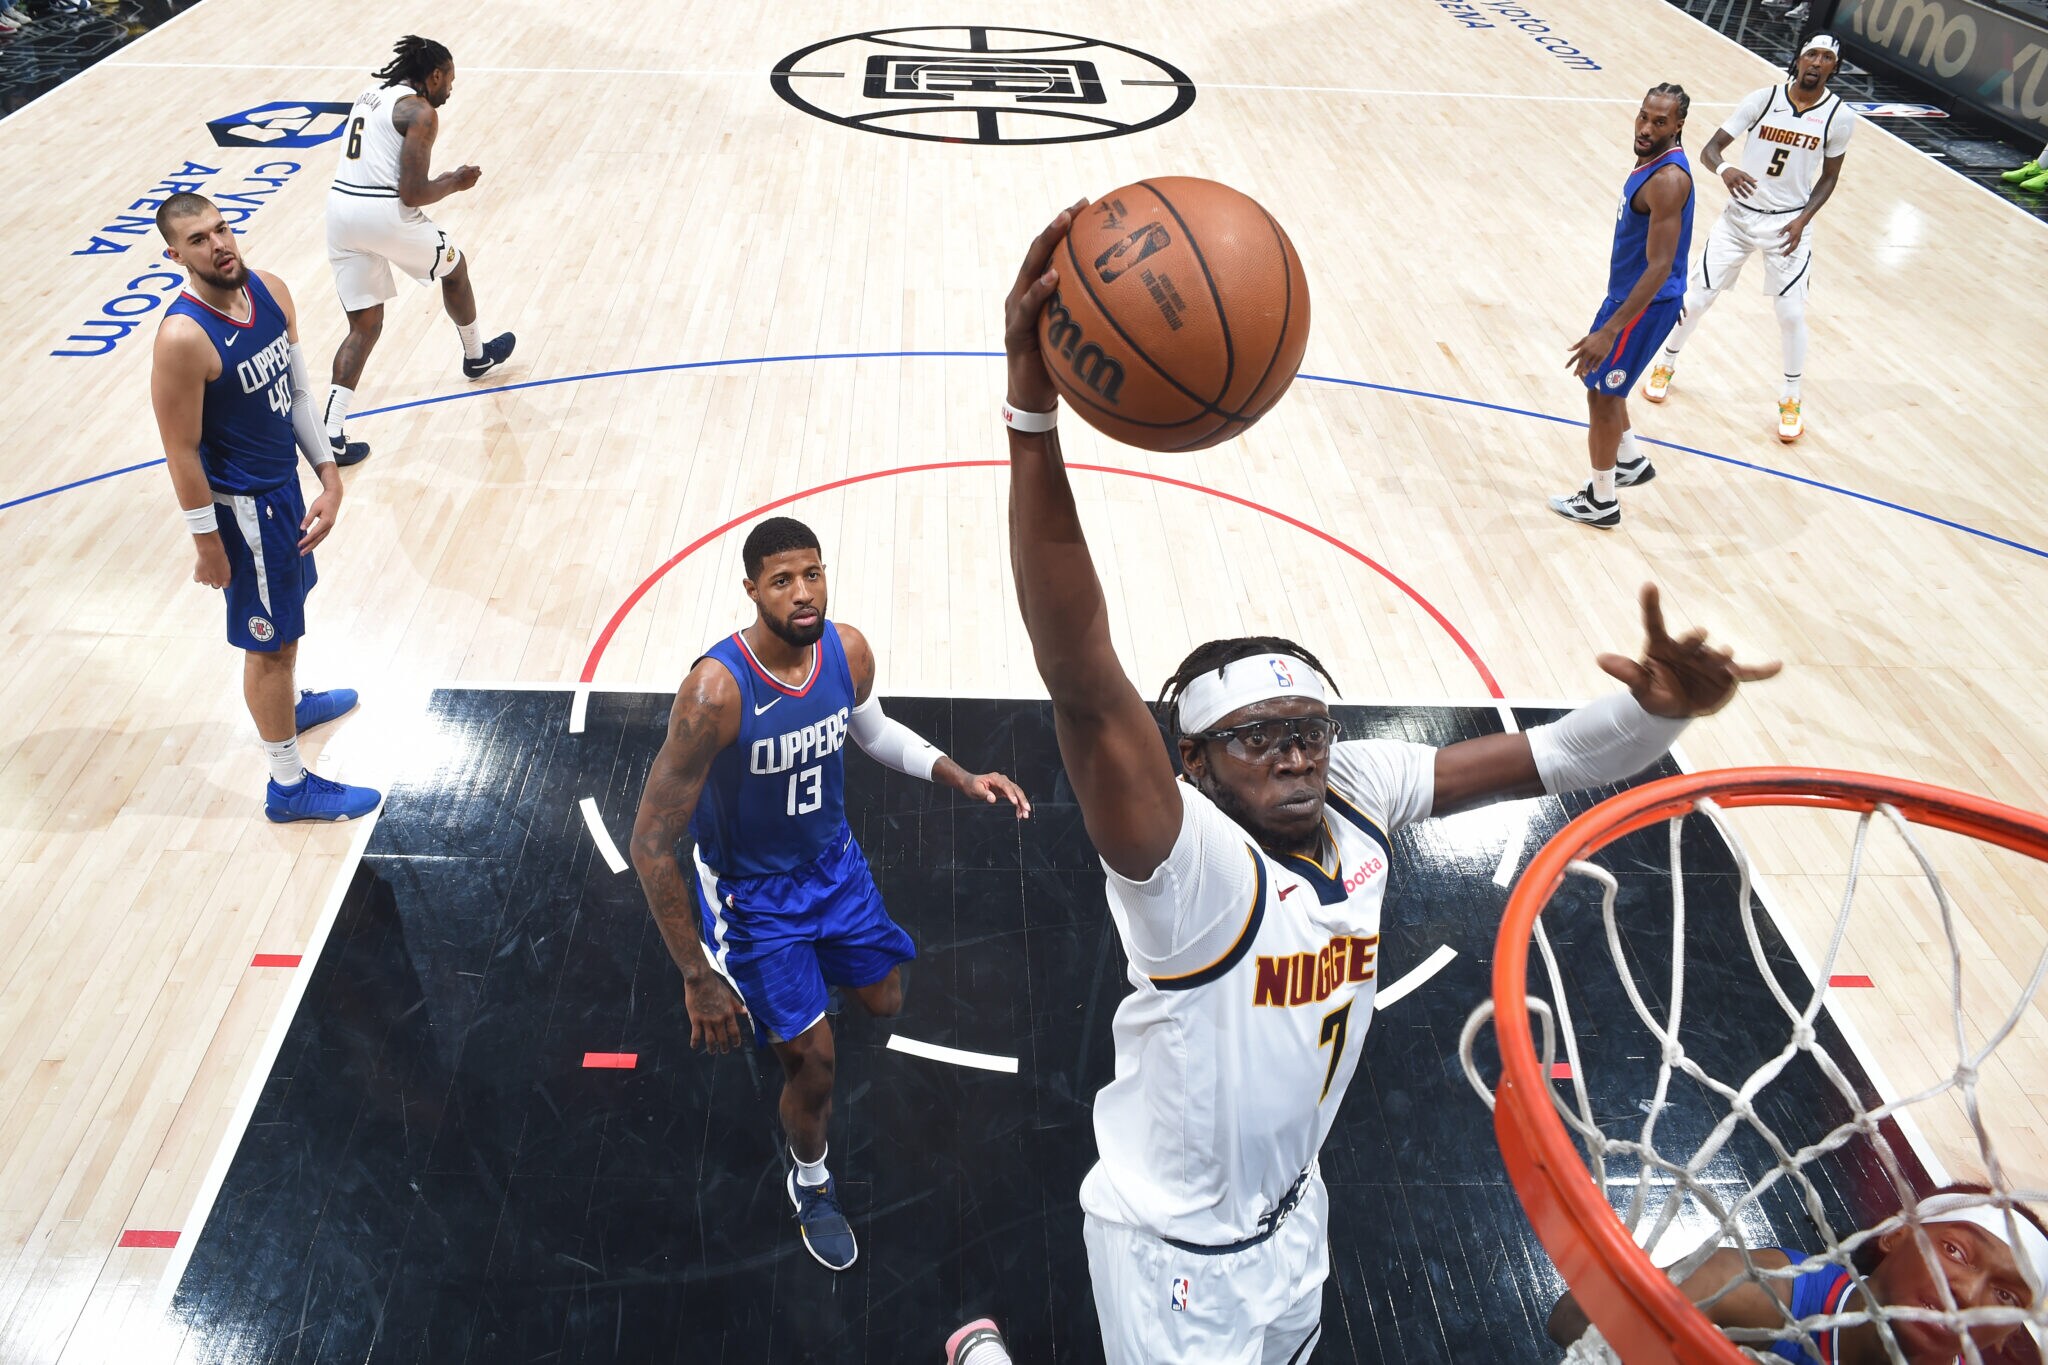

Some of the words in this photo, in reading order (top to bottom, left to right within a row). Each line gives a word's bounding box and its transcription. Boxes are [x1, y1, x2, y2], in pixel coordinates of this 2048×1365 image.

[1435, 0, 1496, 28] ENA
[1480, 0, 1602, 70] ypto.com
[346, 117, 365, 160] 6
[1757, 124, 1821, 151] NUGGETS
[1766, 147, 1791, 177] 5
[70, 160, 222, 256] ARENA
[236, 329, 291, 394] CLIPPERS
[267, 372, 292, 418] 40
[750, 706, 849, 775] CLIPPERS
[786, 765, 823, 816] 13
[1343, 856, 1383, 894] botta
[1252, 933, 1380, 1009] NUGGE
[1317, 996, 1356, 1107] 7
